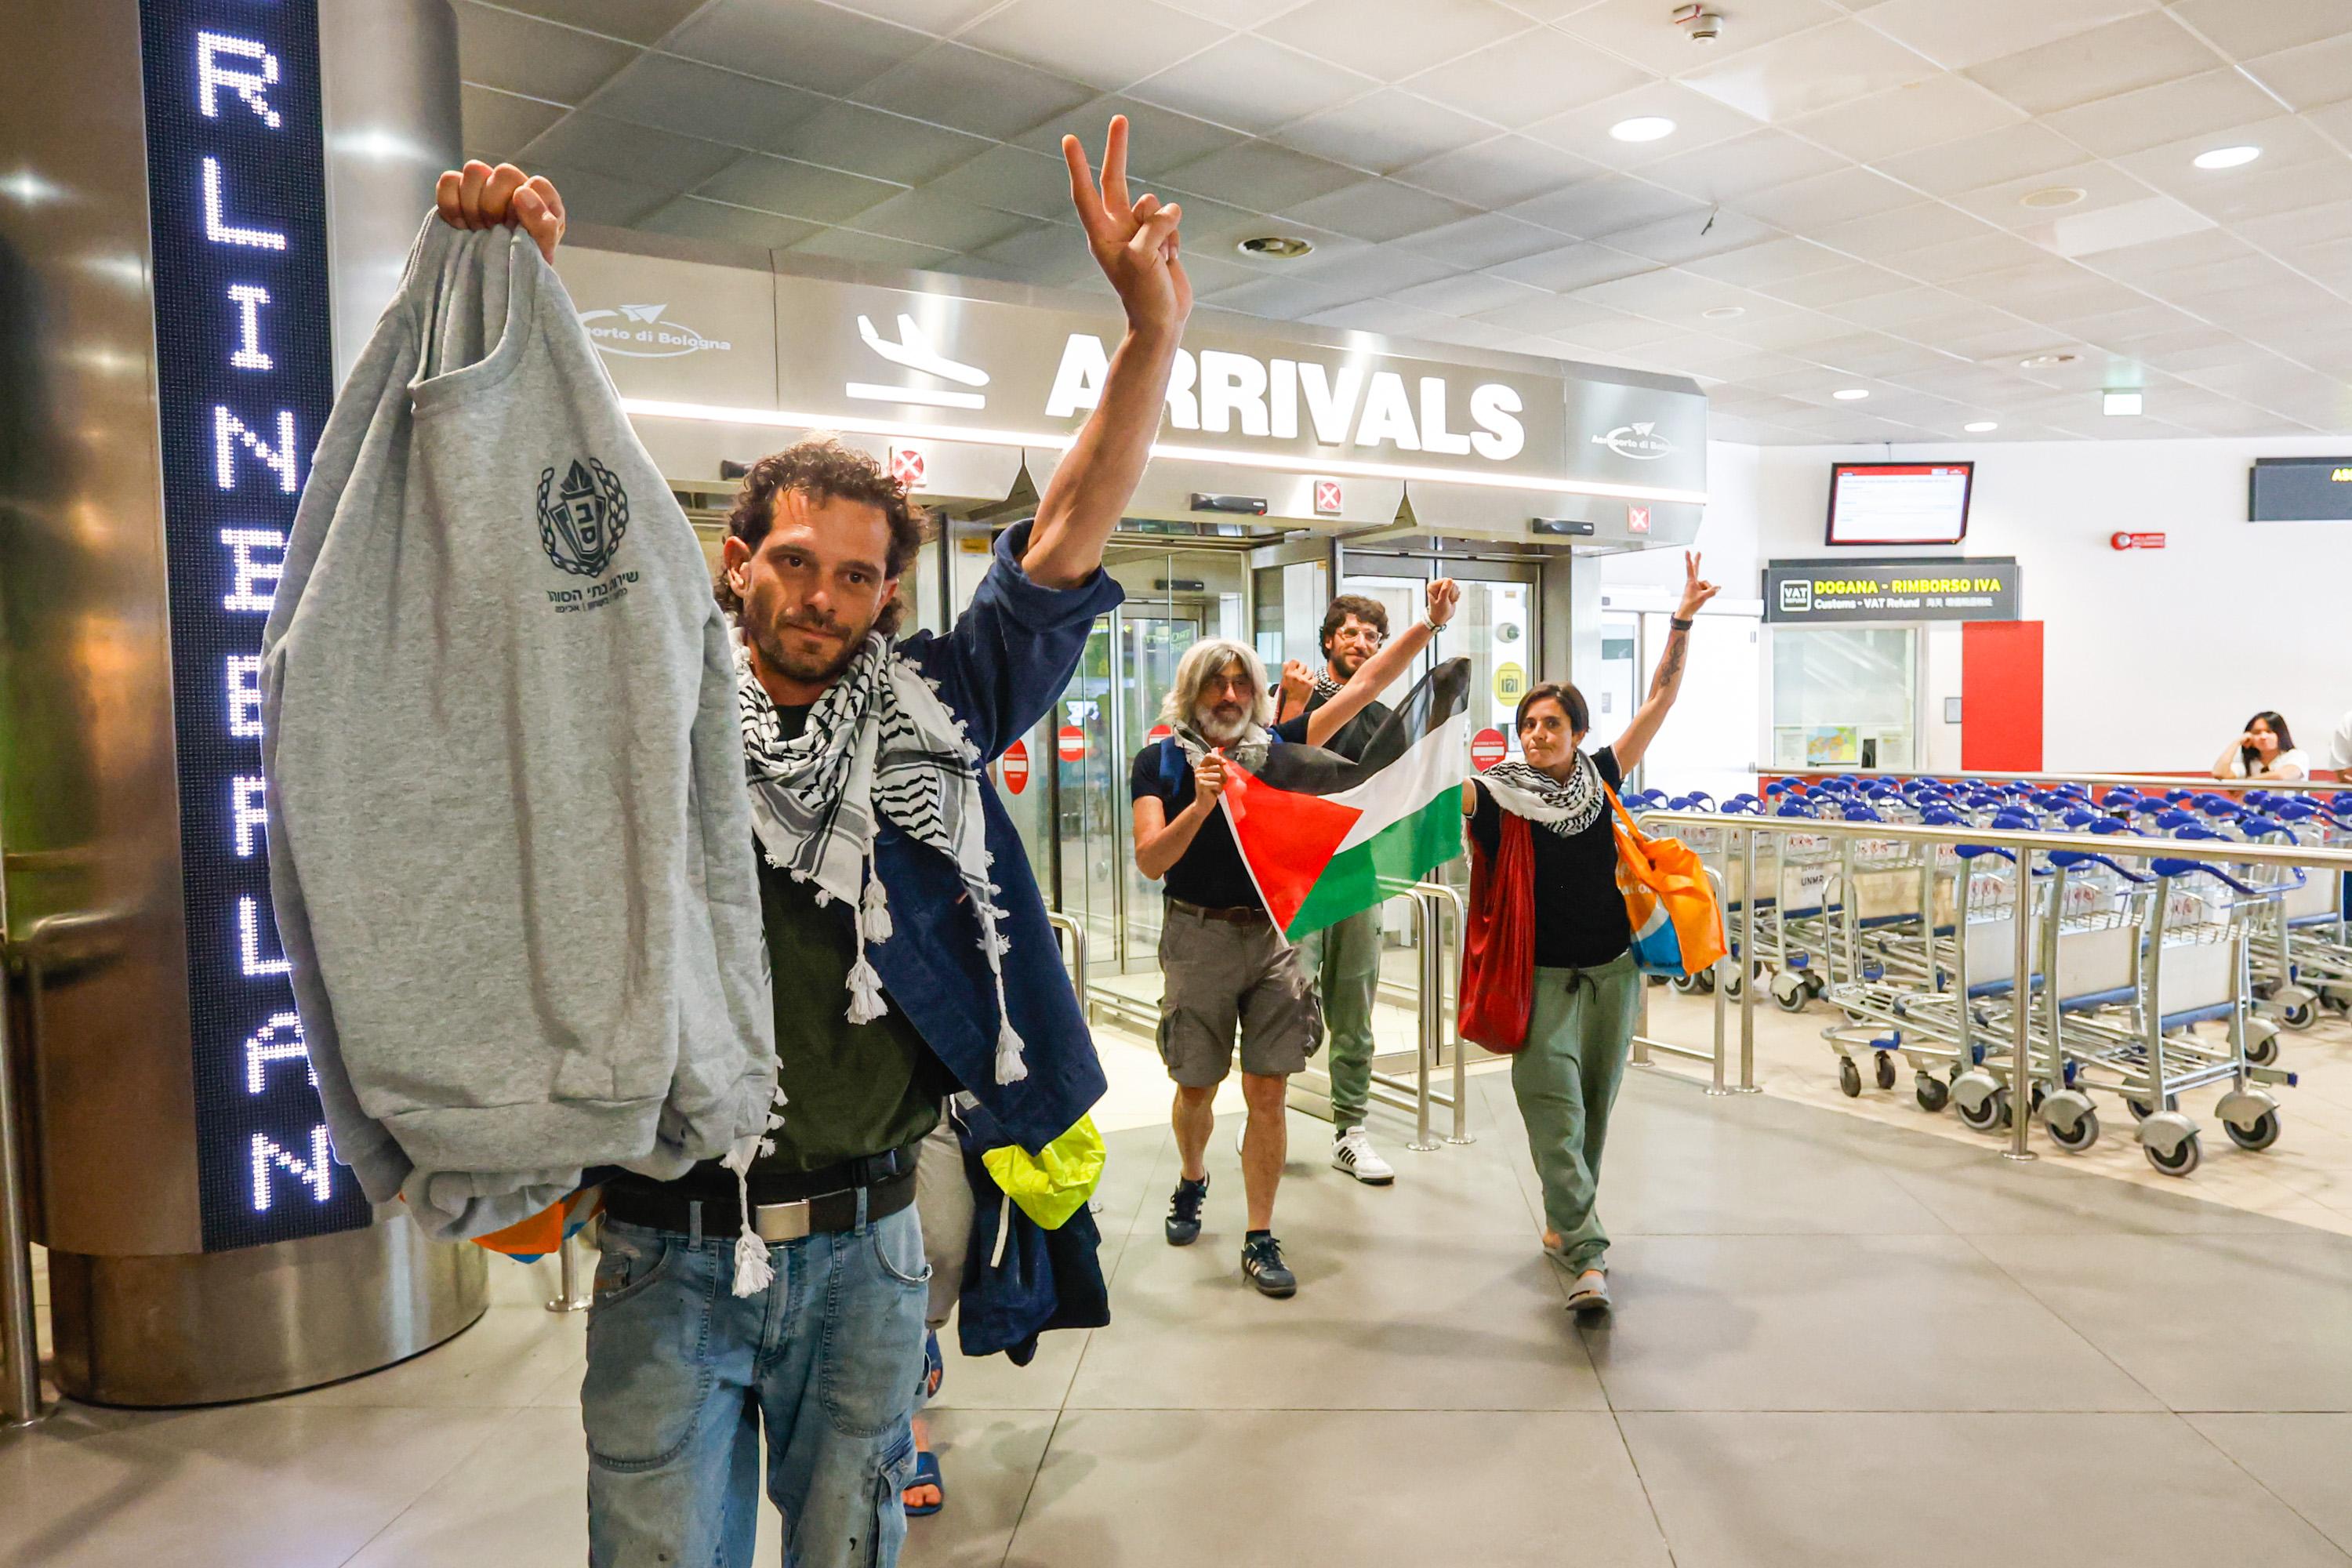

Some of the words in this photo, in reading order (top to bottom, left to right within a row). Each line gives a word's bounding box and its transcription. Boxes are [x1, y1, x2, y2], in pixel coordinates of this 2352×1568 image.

[636, 330, 653, 343] di
[659, 332, 731, 350] Bologna
[1784, 587, 1807, 597] VAT
[1814, 580, 1878, 594] DOGANA
[1892, 579, 1971, 593] RIMBORSO
[1974, 578, 2002, 592] IVA
[1814, 598, 1857, 610] Customs
[1864, 598, 1886, 609] VAT
[1886, 597, 1920, 608] Refund
